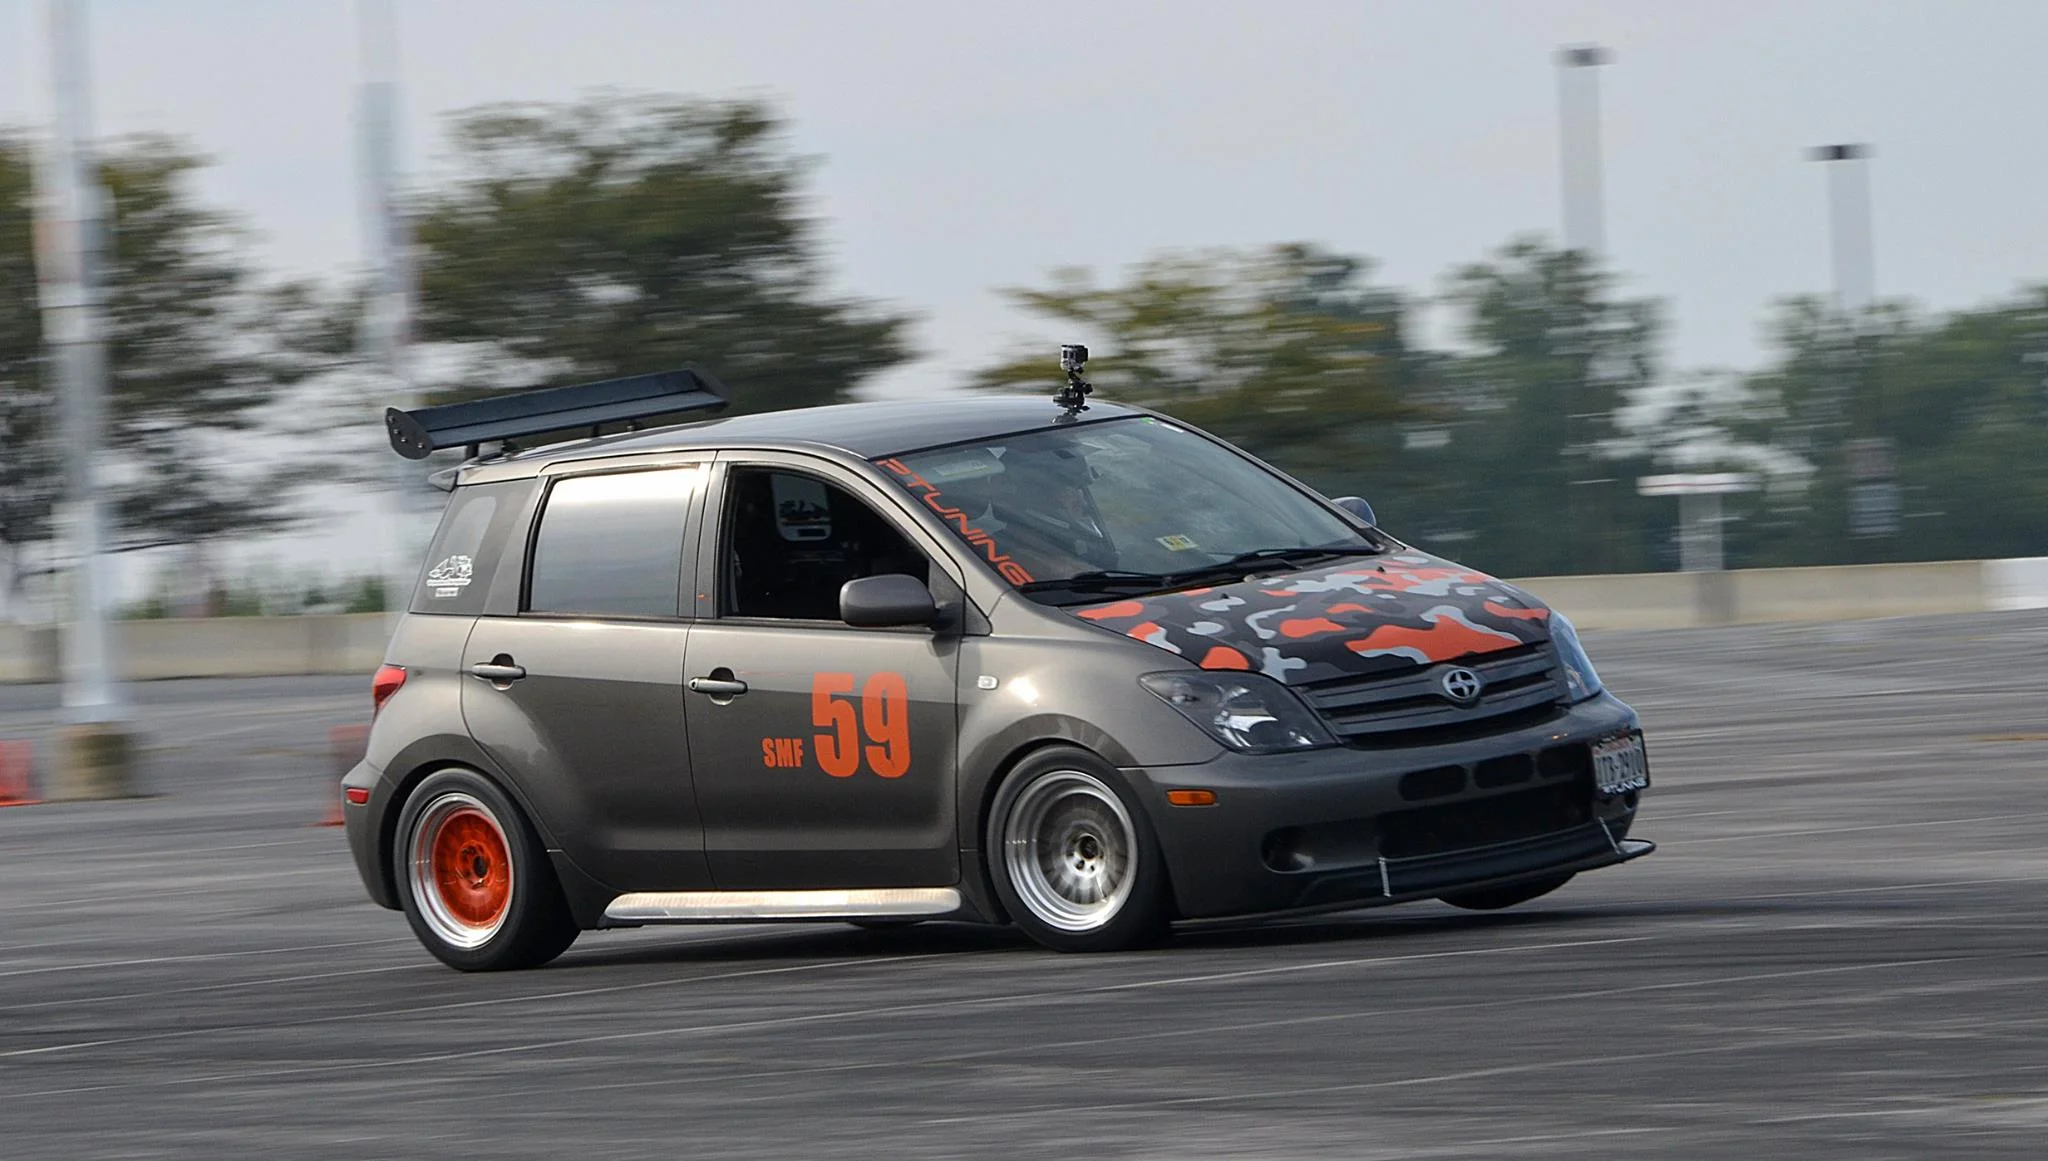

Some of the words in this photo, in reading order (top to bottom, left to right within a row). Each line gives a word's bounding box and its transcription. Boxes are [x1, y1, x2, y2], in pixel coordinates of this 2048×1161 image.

[876, 458, 1035, 586] PTUNING
[761, 737, 804, 768] SMF
[812, 671, 911, 778] 59
